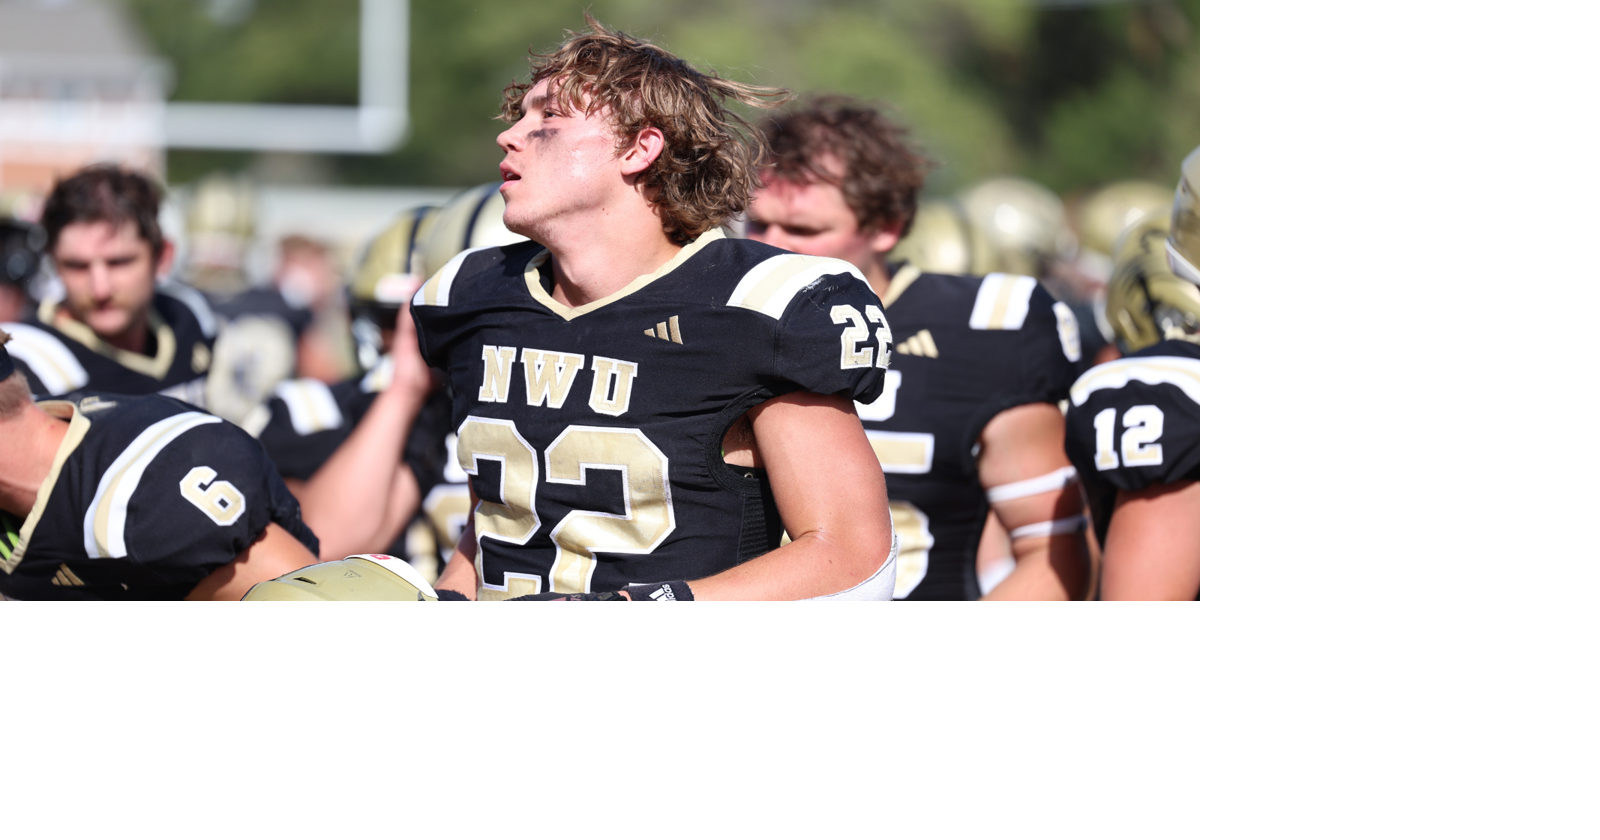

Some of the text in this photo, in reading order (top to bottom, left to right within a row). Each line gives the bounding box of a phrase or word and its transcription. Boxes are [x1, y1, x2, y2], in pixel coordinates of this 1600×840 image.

[829, 304, 893, 370] 22
[478, 344, 638, 417] NWU
[1094, 404, 1164, 471] 12
[179, 465, 246, 526] 6
[456, 415, 676, 600] 22
